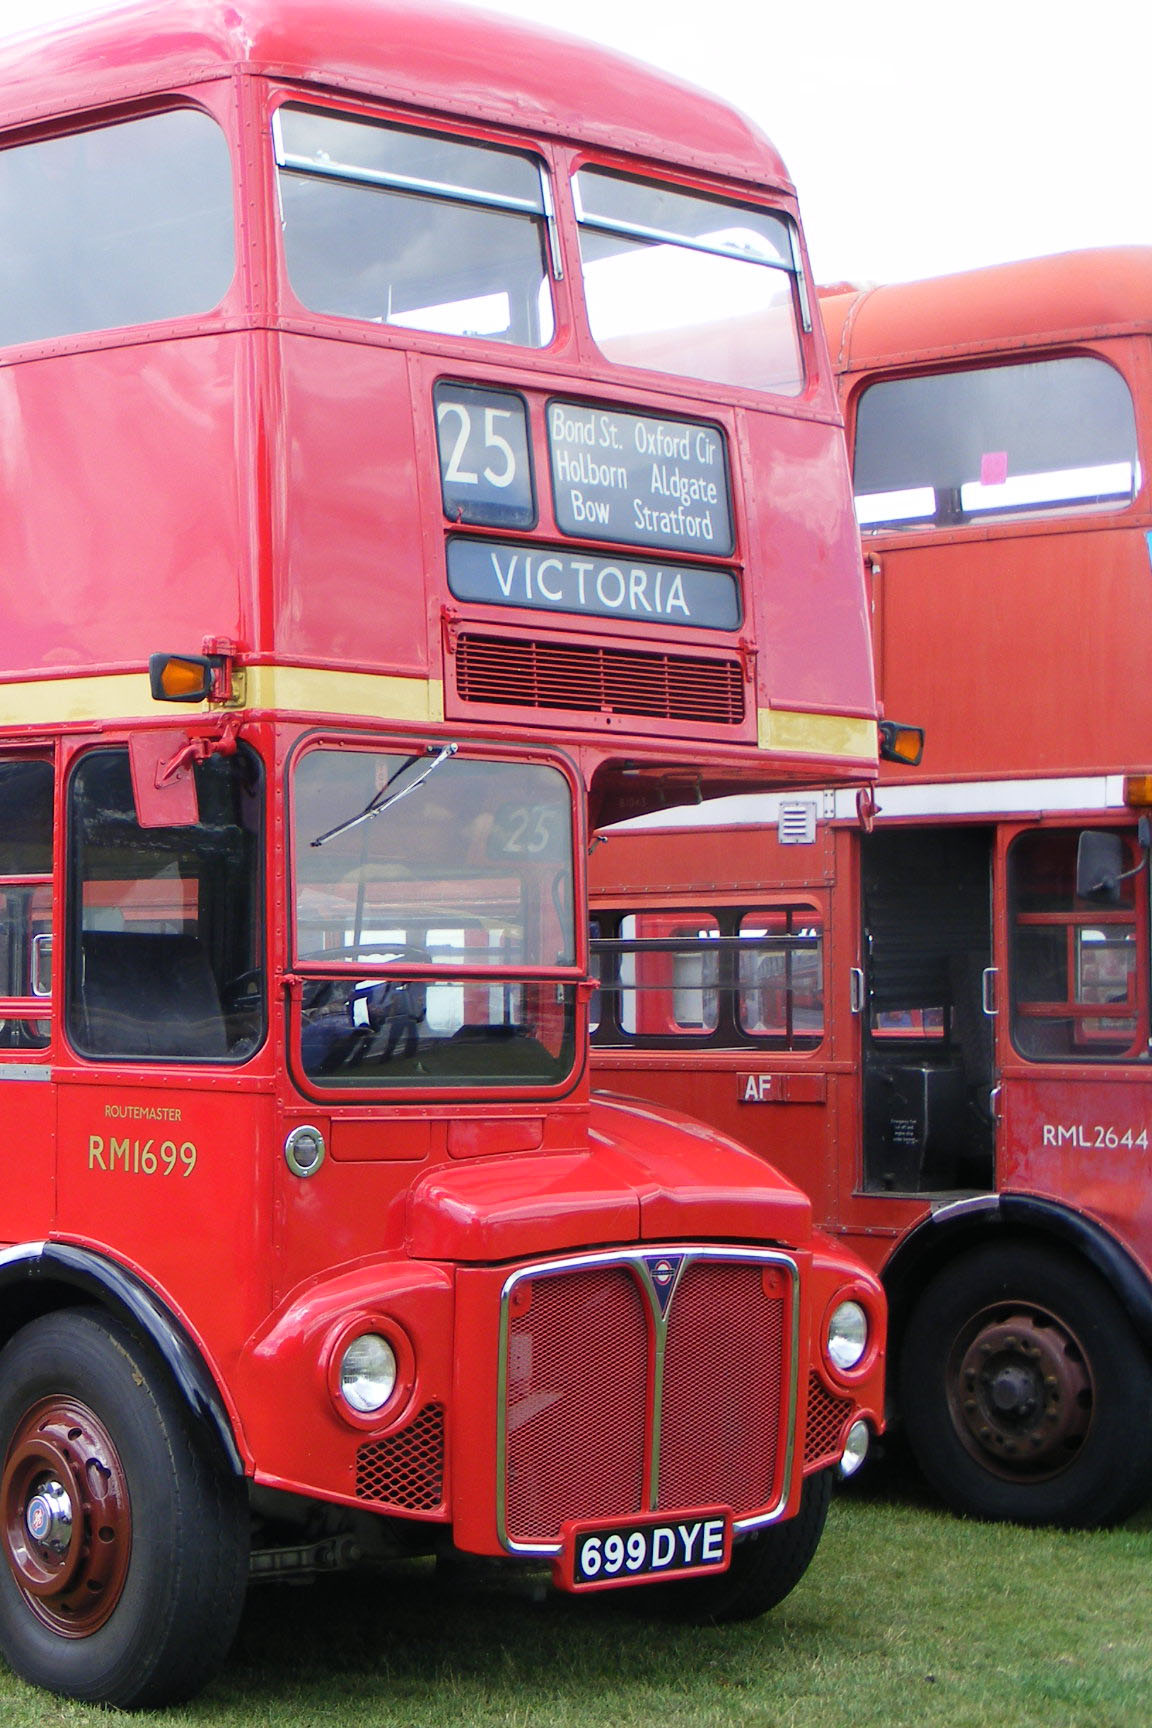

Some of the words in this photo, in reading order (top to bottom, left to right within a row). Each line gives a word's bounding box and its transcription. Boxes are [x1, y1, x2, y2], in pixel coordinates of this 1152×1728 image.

[438, 403, 516, 488] 25
[552, 408, 595, 447] Bond
[600, 415, 623, 450] St.
[635, 422, 689, 461] Oxford
[696, 432, 716, 465] Cir
[556, 450, 627, 489] Holborn
[651, 463, 717, 506] Aldgate
[571, 490, 610, 524] Bow
[633, 499, 713, 540] Stratford
[491, 553, 690, 616] VICTORIA
[105, 1105, 182, 1121] ROUTEMASTER
[745, 1075, 771, 1101] AF
[89, 1135, 197, 1177] RM1699
[1043, 1124, 1148, 1150] RML2644
[581, 1532, 646, 1576] 699
[652, 1520, 724, 1568] DYE
